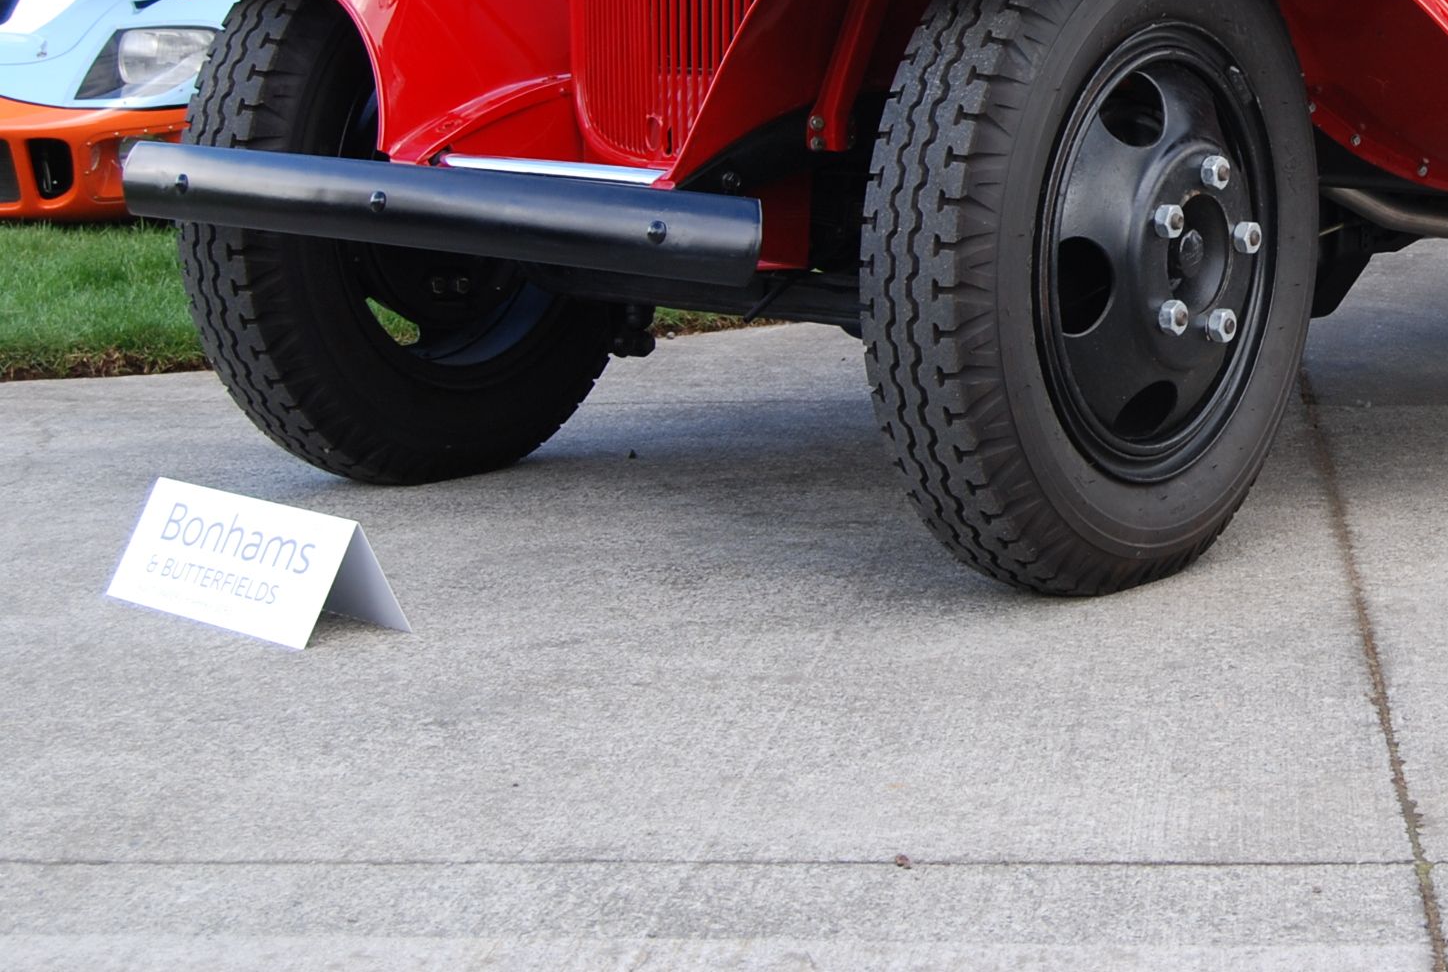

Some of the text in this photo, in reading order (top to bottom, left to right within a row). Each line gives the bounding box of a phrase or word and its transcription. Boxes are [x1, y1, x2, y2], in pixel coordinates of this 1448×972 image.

[159, 502, 316, 574] Bonhams
[146, 554, 159, 573] &
[161, 557, 280, 605] BUTTERFIELDS
